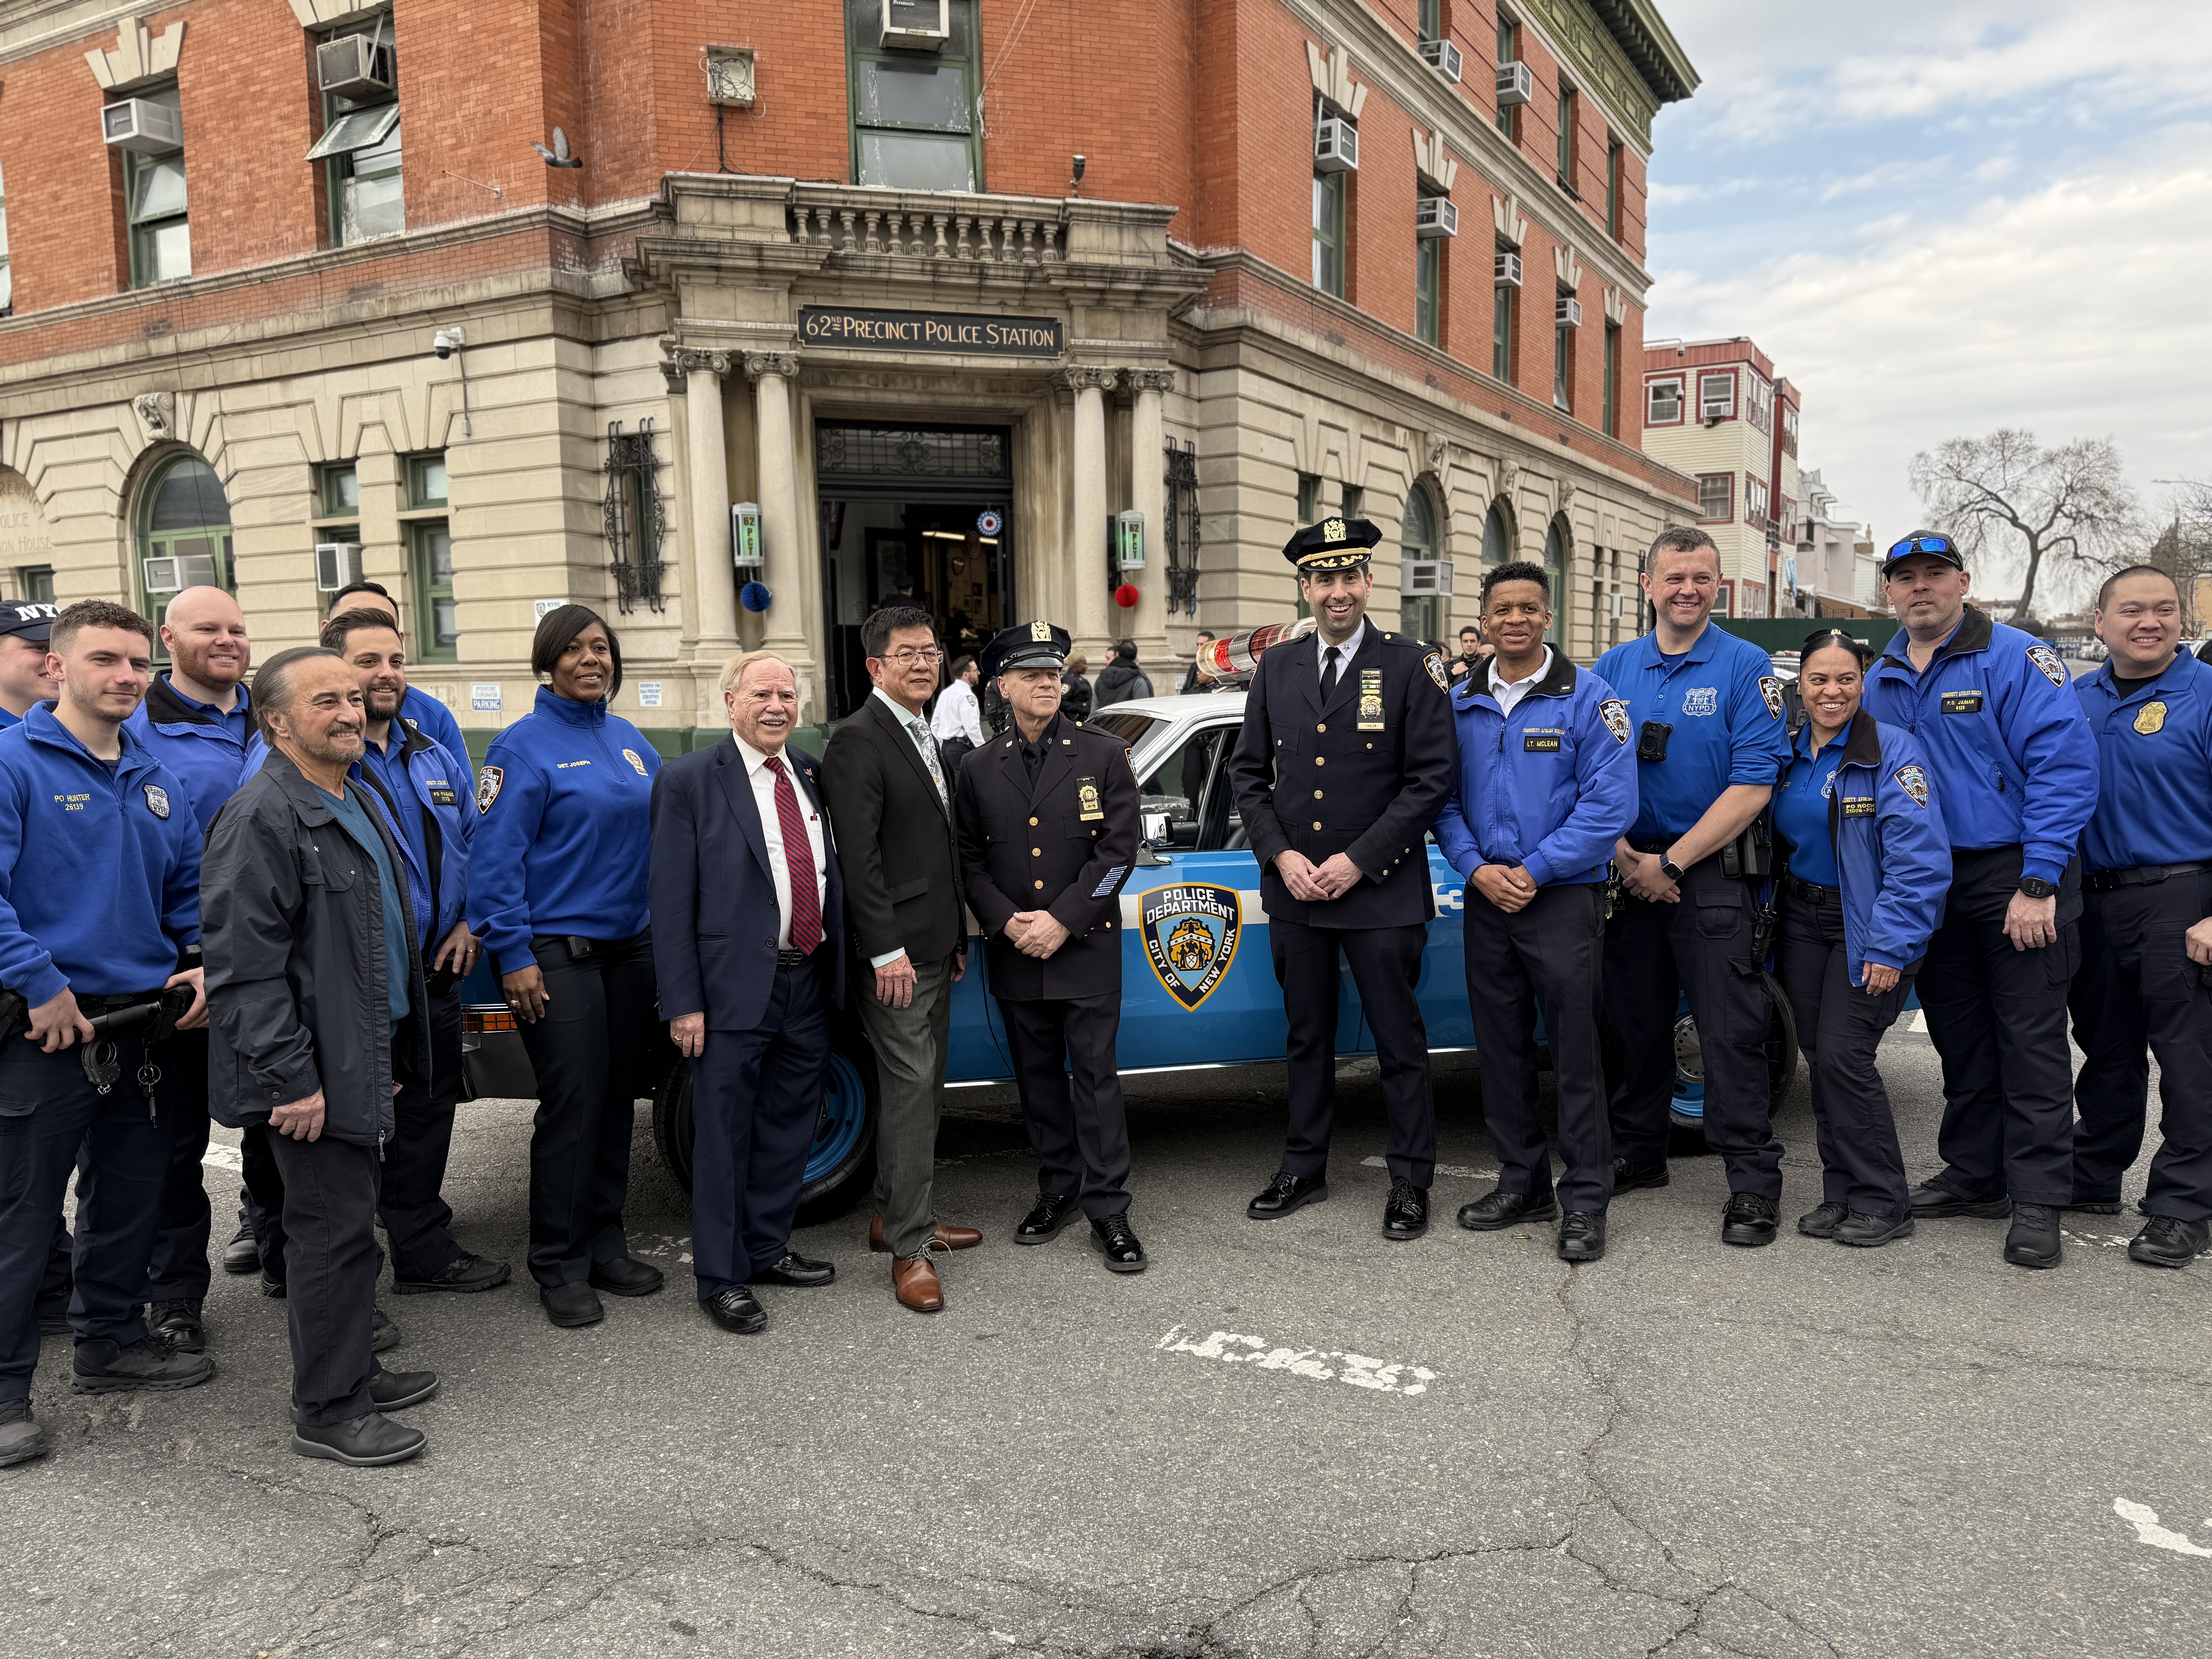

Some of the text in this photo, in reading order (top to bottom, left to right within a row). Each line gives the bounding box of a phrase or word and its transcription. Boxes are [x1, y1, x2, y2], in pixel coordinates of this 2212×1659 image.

[843, 316, 921, 340] PRECINCT
[926, 321, 982, 343] POLICE
[987, 324, 1053, 347] STATION
[744, 517, 755, 526] 62
[1130, 524, 1139, 532] 62
[19, 536, 52, 551] HOUSE
[473, 700, 500, 709] PARKING
[67, 793, 90, 802] HUNTER
[153, 805, 168, 815] NYPD
[1163, 888, 1216, 903] POLICE
[1147, 900, 1235, 925] DEPARTMENT
[1149, 928, 1236, 993] CITY OF NEW YORK
